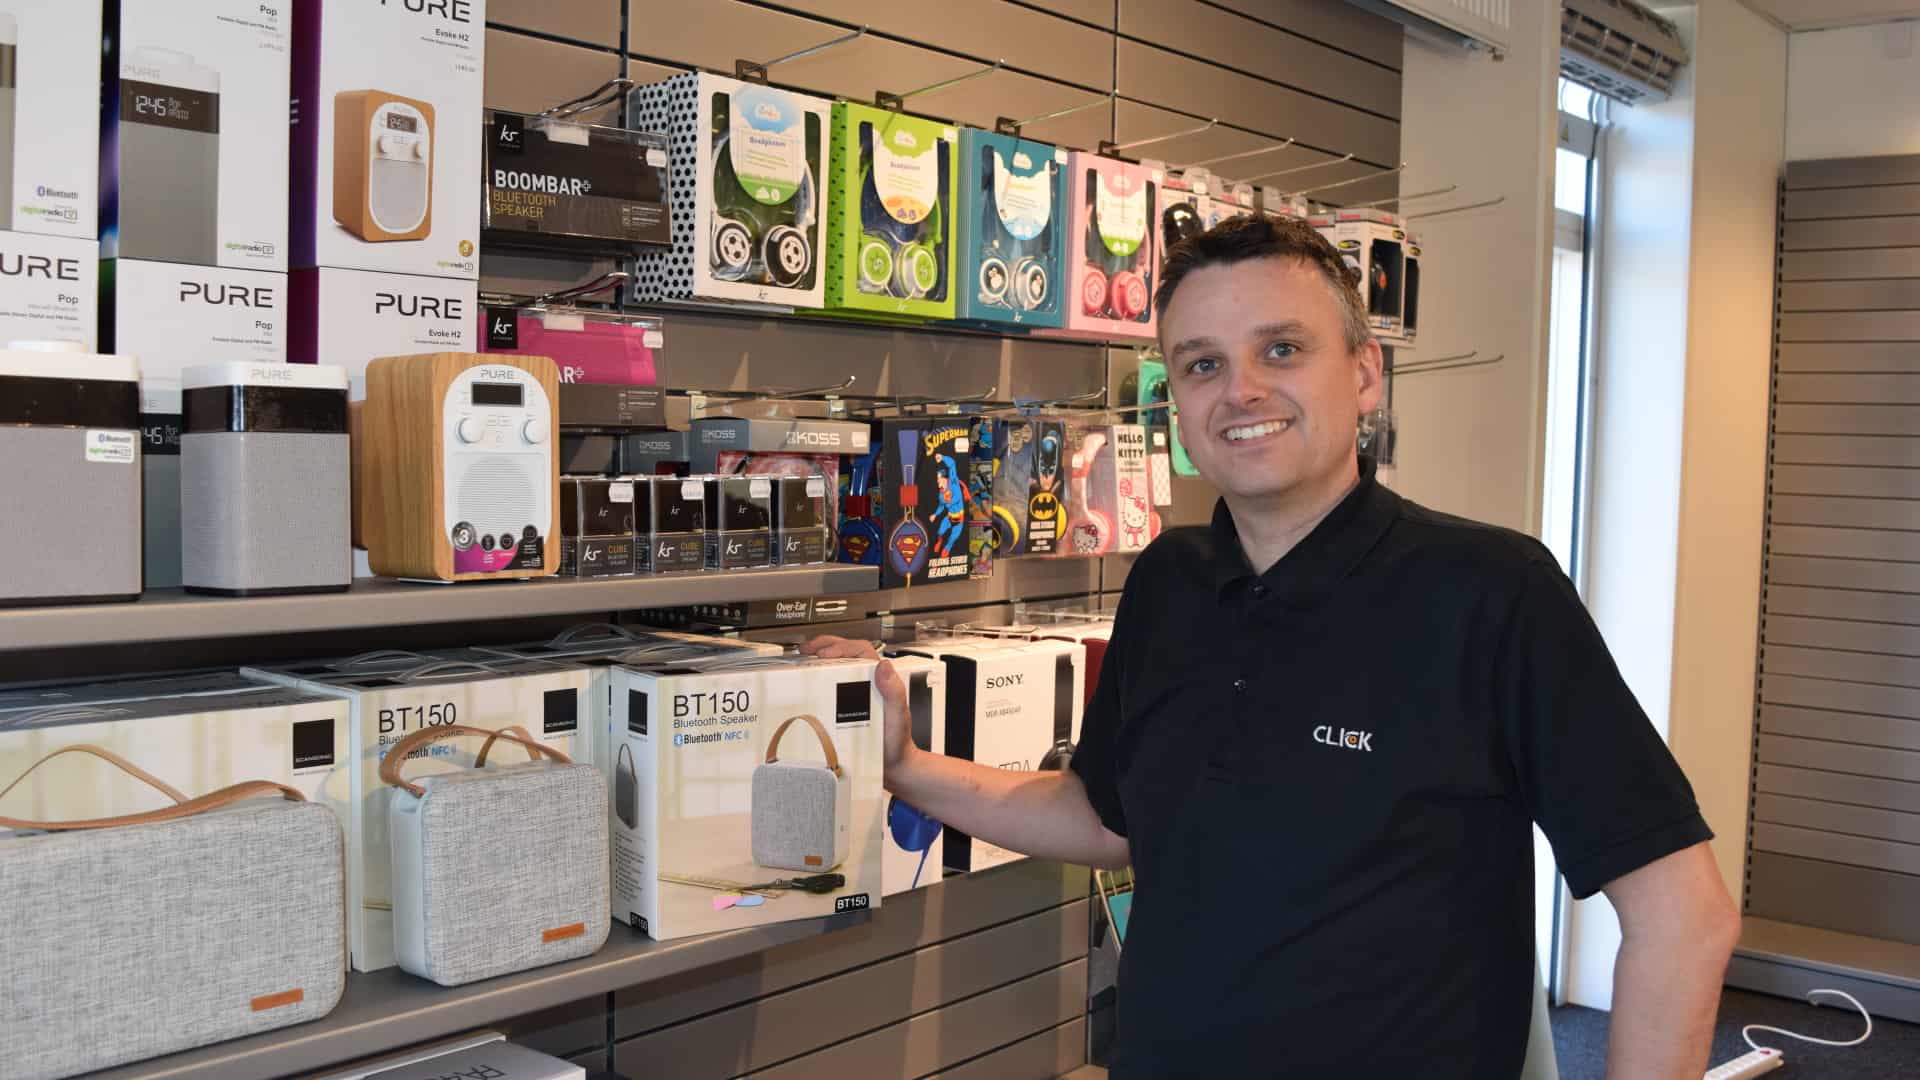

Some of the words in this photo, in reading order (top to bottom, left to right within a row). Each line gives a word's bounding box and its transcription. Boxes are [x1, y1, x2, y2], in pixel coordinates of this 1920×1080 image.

[260, 5, 277, 16] Pop
[381, 0, 471, 23] URE
[493, 190, 557, 207] BLUETOOTH
[494, 203, 544, 218] SPEAKER
[0, 253, 80, 281] URE
[58, 294, 79, 304] Pop
[180, 281, 273, 308] PURE
[376, 292, 462, 320] PURE
[255, 320, 273, 330] Pop
[428, 328, 449, 338] Evoke
[451, 330, 462, 339] H2
[480, 369, 514, 379] PURE
[708, 429, 736, 439] KOSS
[796, 432, 841, 446] KOSS
[1117, 433, 1144, 444] HELLO
[923, 427, 969, 457] SUPERMAN
[1117, 448, 1144, 458] KITTY
[928, 565, 968, 578] HEADPHONES
[776, 601, 807, 612] Over-Ear
[985, 673, 1023, 688] SONY
[673, 690, 750, 717] BT150
[379, 702, 456, 733] BT150
[673, 716, 718, 729] Bluetooth
[719, 712, 758, 725] Speaker
[684, 731, 722, 745] Bluetooth
[724, 731, 742, 741] NFC
[1313, 725, 1373, 752] CLICK
[837, 895, 867, 910] BT150
